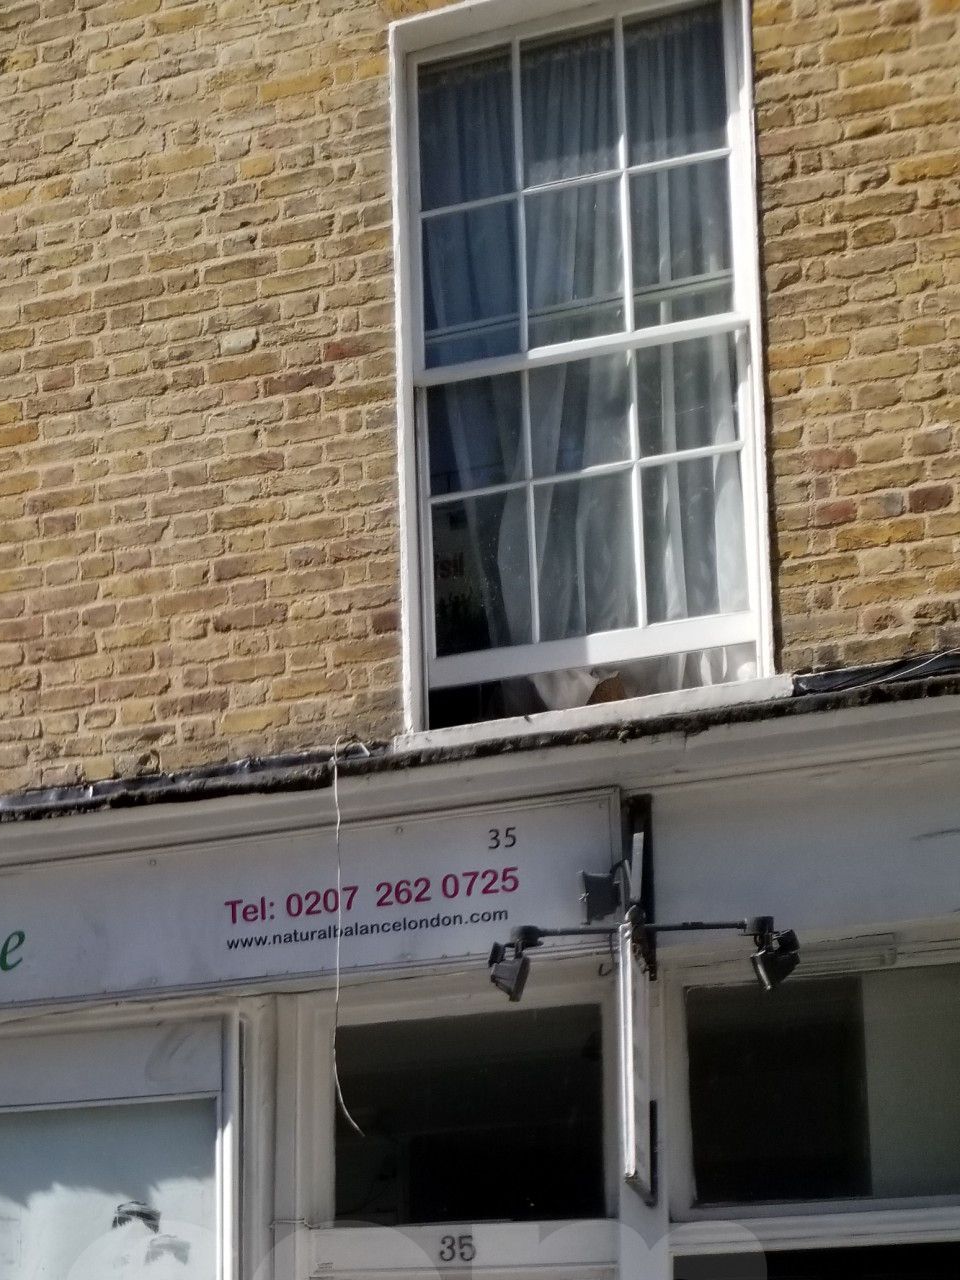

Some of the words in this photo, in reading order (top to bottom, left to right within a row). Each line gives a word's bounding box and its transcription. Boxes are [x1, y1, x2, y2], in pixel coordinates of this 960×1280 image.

[487, 826, 518, 850] 35
[224, 897, 276, 925] Tel:
[285, 885, 360, 919] 0207
[376, 877, 432, 908] 262
[442, 866, 521, 900] 0725
[226, 907, 509, 950] www.naturalbalancelondon.com
[439, 1235, 477, 1262] 35
